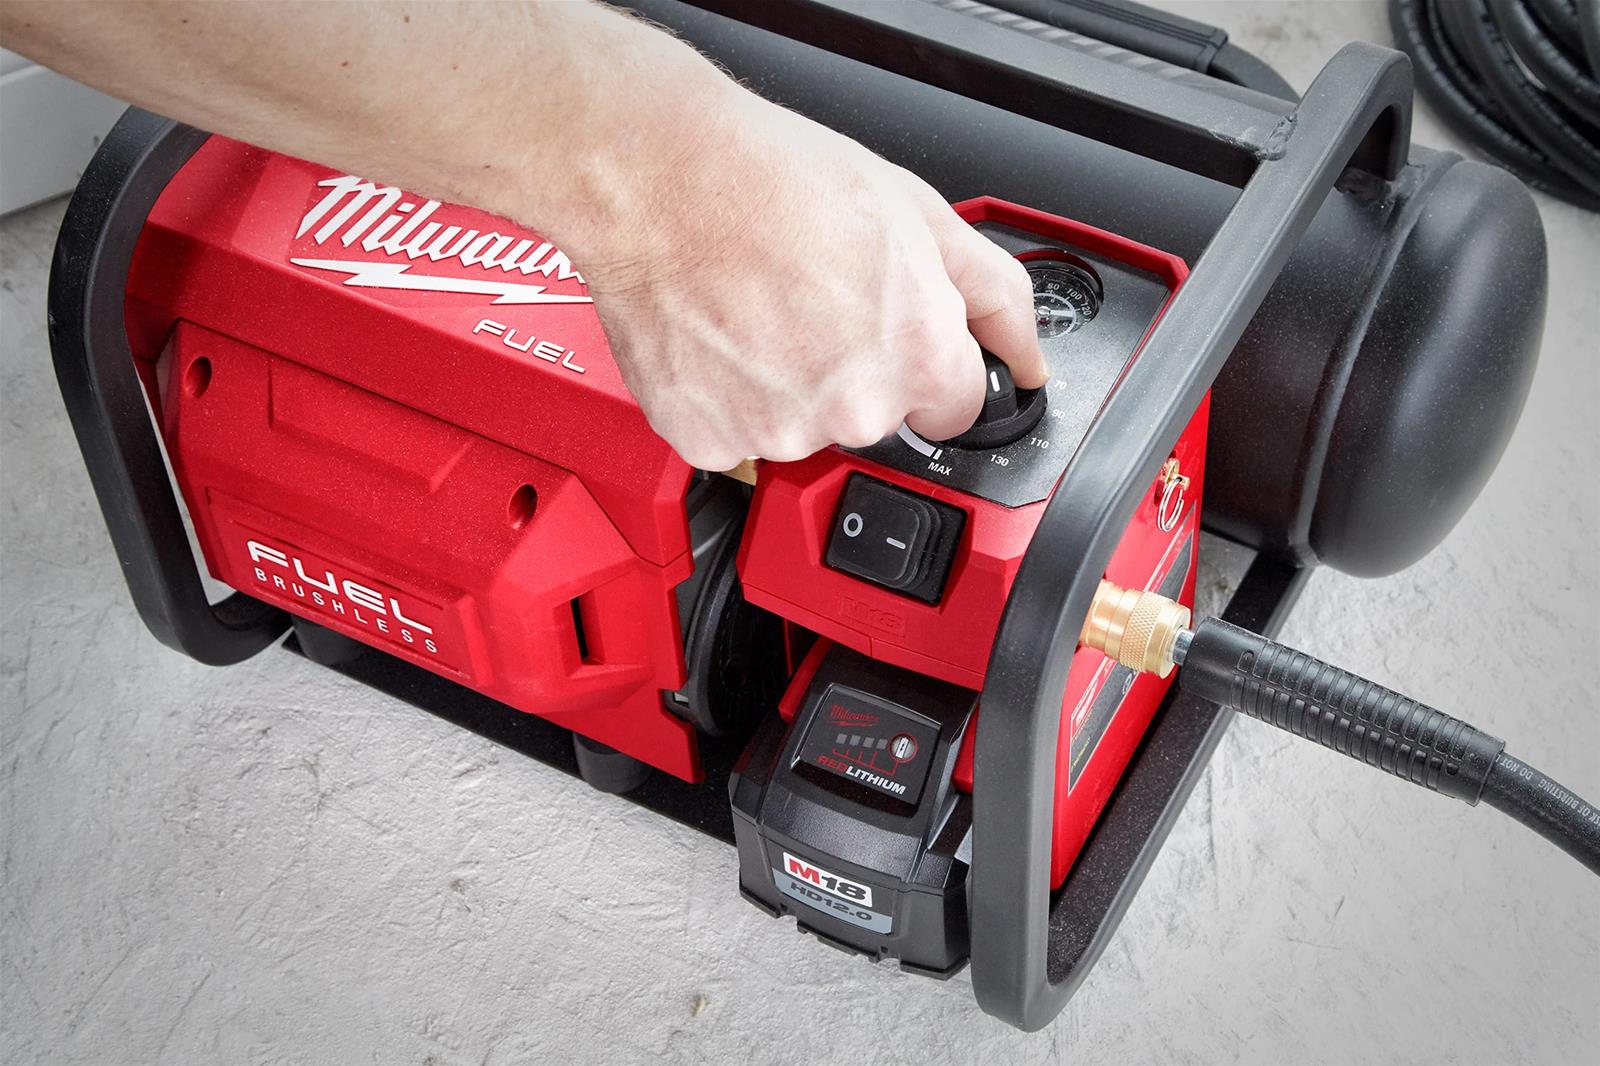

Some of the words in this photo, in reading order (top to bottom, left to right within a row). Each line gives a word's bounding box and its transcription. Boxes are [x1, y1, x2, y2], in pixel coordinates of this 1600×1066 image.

[1066, 287, 1083, 301] 100
[1080, 302, 1092, 316] 120
[473, 318, 587, 374] FUEL
[1054, 379, 1068, 390] 70
[1052, 408, 1066, 420] 90
[1030, 437, 1050, 449] 110
[989, 454, 1010, 468] 130
[927, 461, 953, 477] MAX
[247, 540, 433, 635] FUEL
[254, 567, 438, 653] BRUSHLESS
[1500, 758, 1520, 772] NOT
[1519, 767, 1534, 780] DO
[1538, 778, 1580, 810] BURSTING
[1577, 804, 1591, 817] OF
[788, 858, 867, 901] M18
[790, 882, 873, 921] HD12.0
